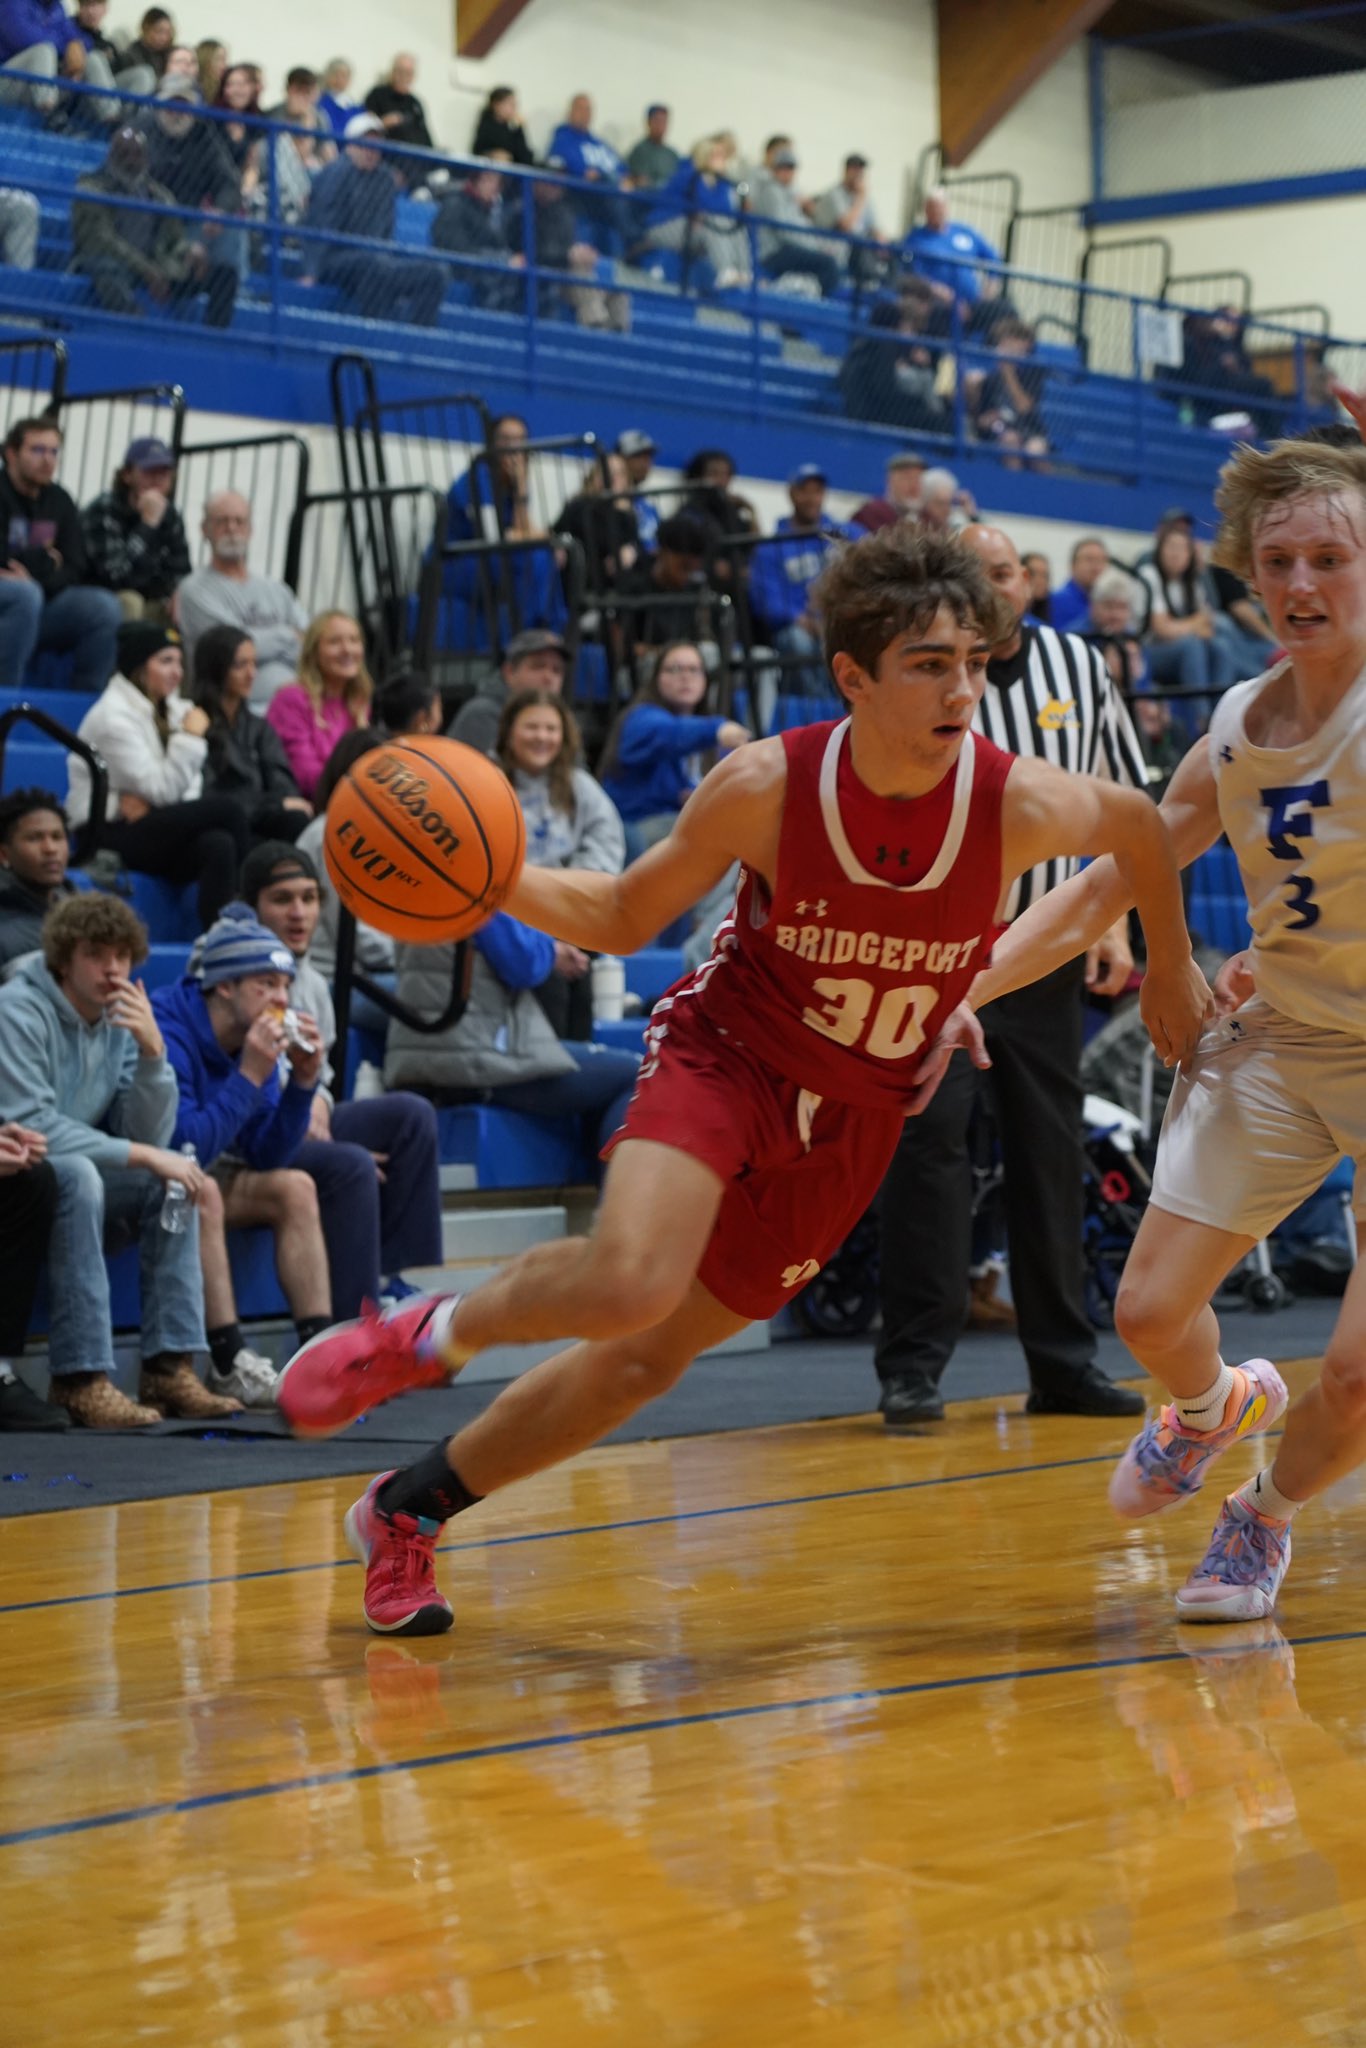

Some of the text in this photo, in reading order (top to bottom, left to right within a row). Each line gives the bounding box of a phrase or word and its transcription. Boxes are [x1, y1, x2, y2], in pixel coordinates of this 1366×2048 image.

[366, 754, 460, 858] Wilson
[395, 870, 422, 888] NXT
[1284, 873, 1321, 929] 3
[775, 924, 982, 974] BRIDGEPORT
[802, 977, 940, 1059] 30
